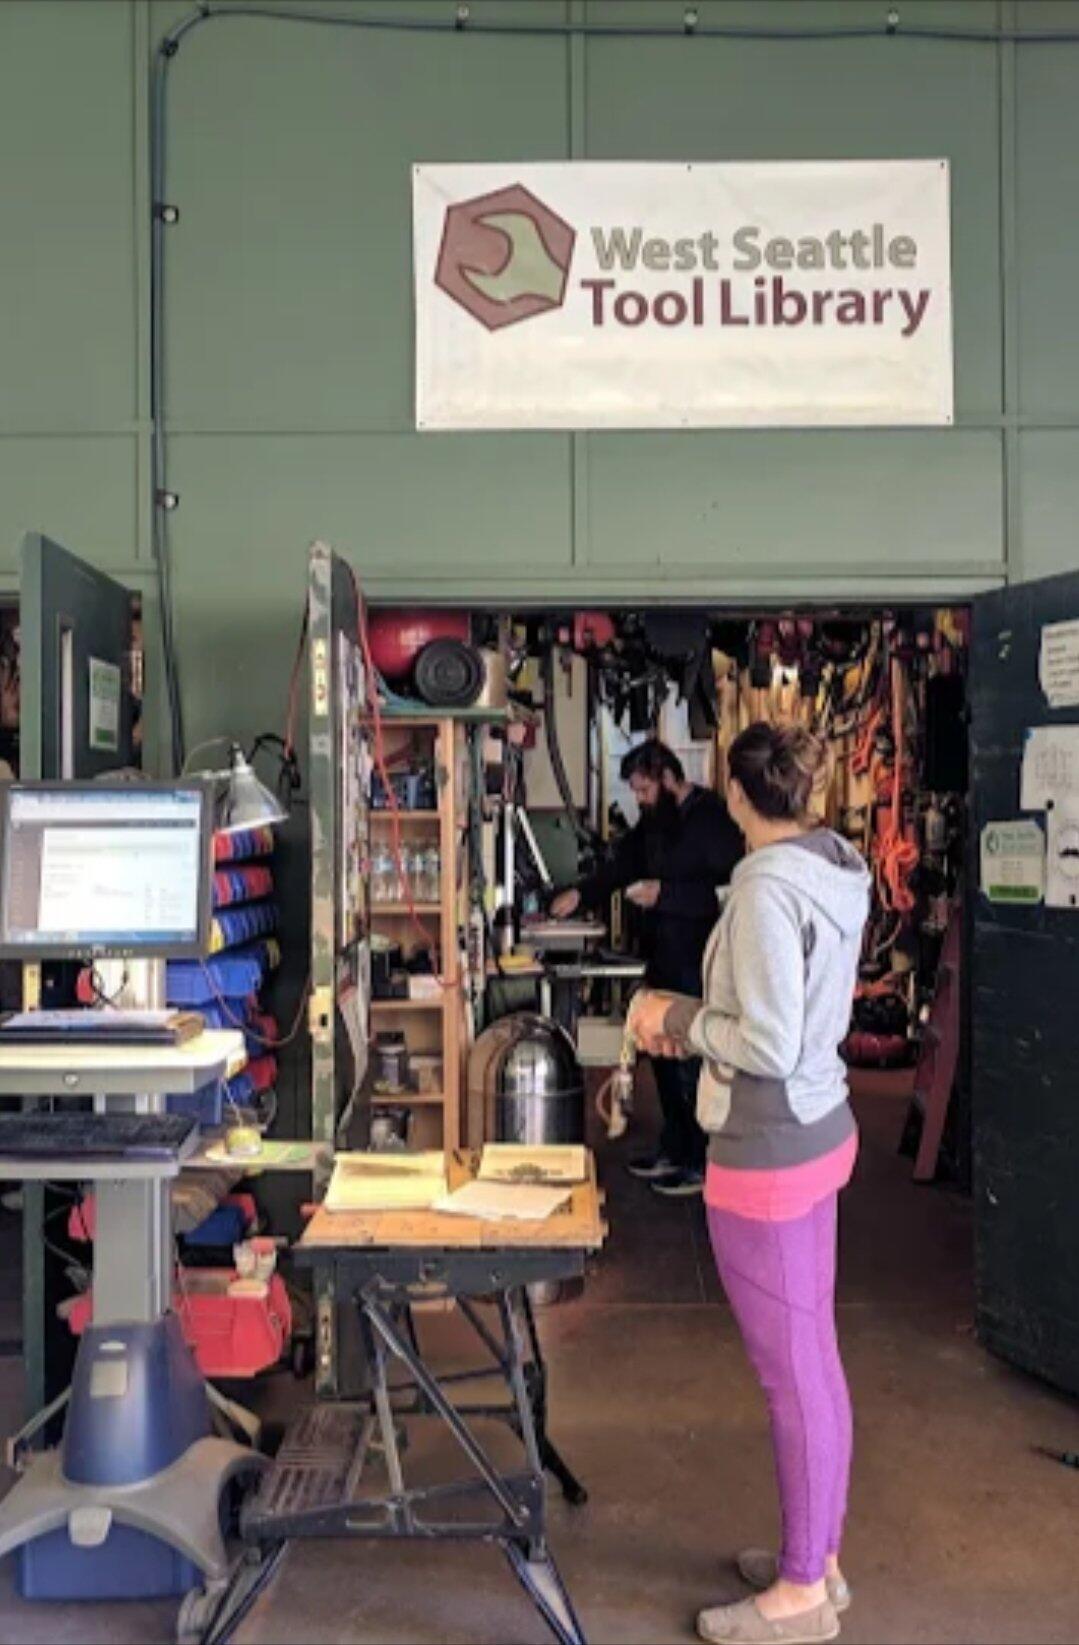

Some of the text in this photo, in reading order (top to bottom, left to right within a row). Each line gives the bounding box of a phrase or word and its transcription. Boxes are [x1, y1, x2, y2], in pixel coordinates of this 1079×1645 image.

[590, 223, 918, 271] West Seattle
[580, 275, 931, 337] Tool Library
